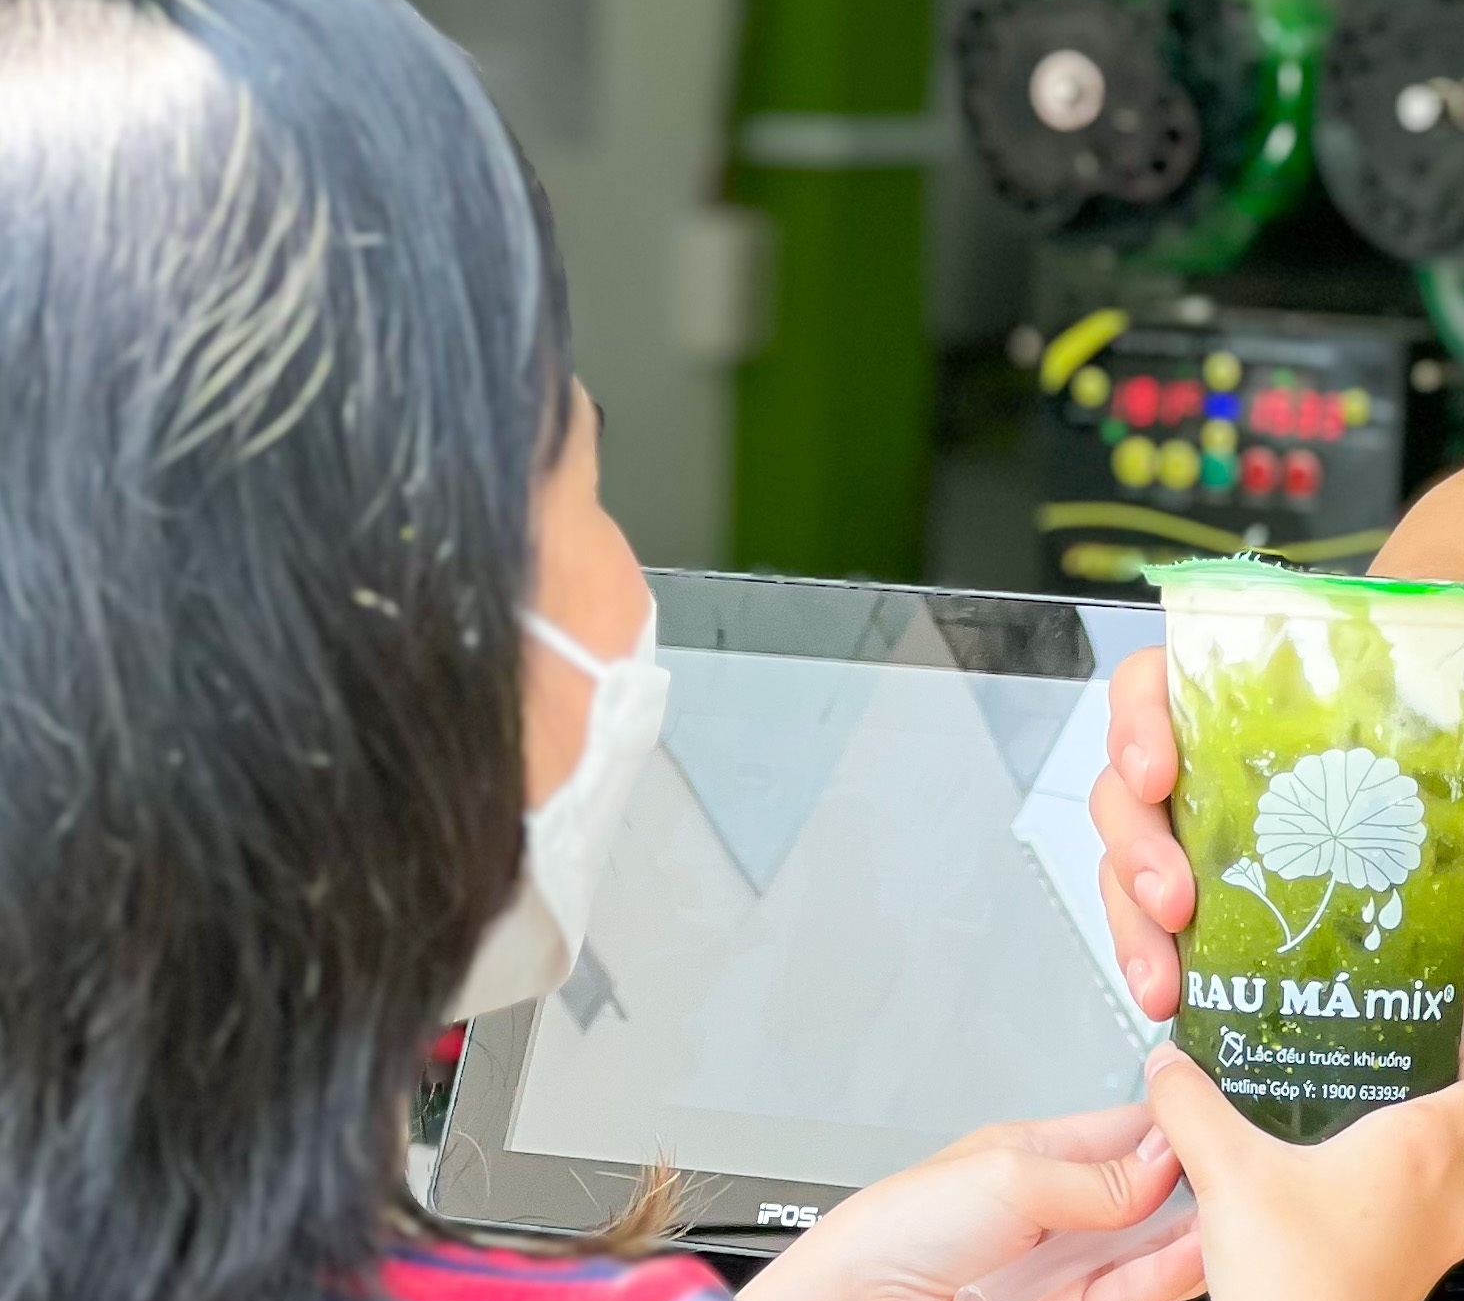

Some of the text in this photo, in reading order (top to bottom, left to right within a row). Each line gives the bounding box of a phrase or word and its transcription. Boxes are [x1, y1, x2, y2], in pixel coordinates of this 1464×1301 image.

[1186, 970, 1267, 1013] RAU
[1279, 971, 1361, 1018] MÁ
[1353, 1051, 1376, 1067] khi
[1221, 1077, 1267, 1096] Hotline
[1270, 1079, 1300, 1100] Góp
[1321, 1083, 1356, 1100] 1900
[1359, 1084, 1407, 1100] 633934
[757, 1202, 823, 1228] iPOS
